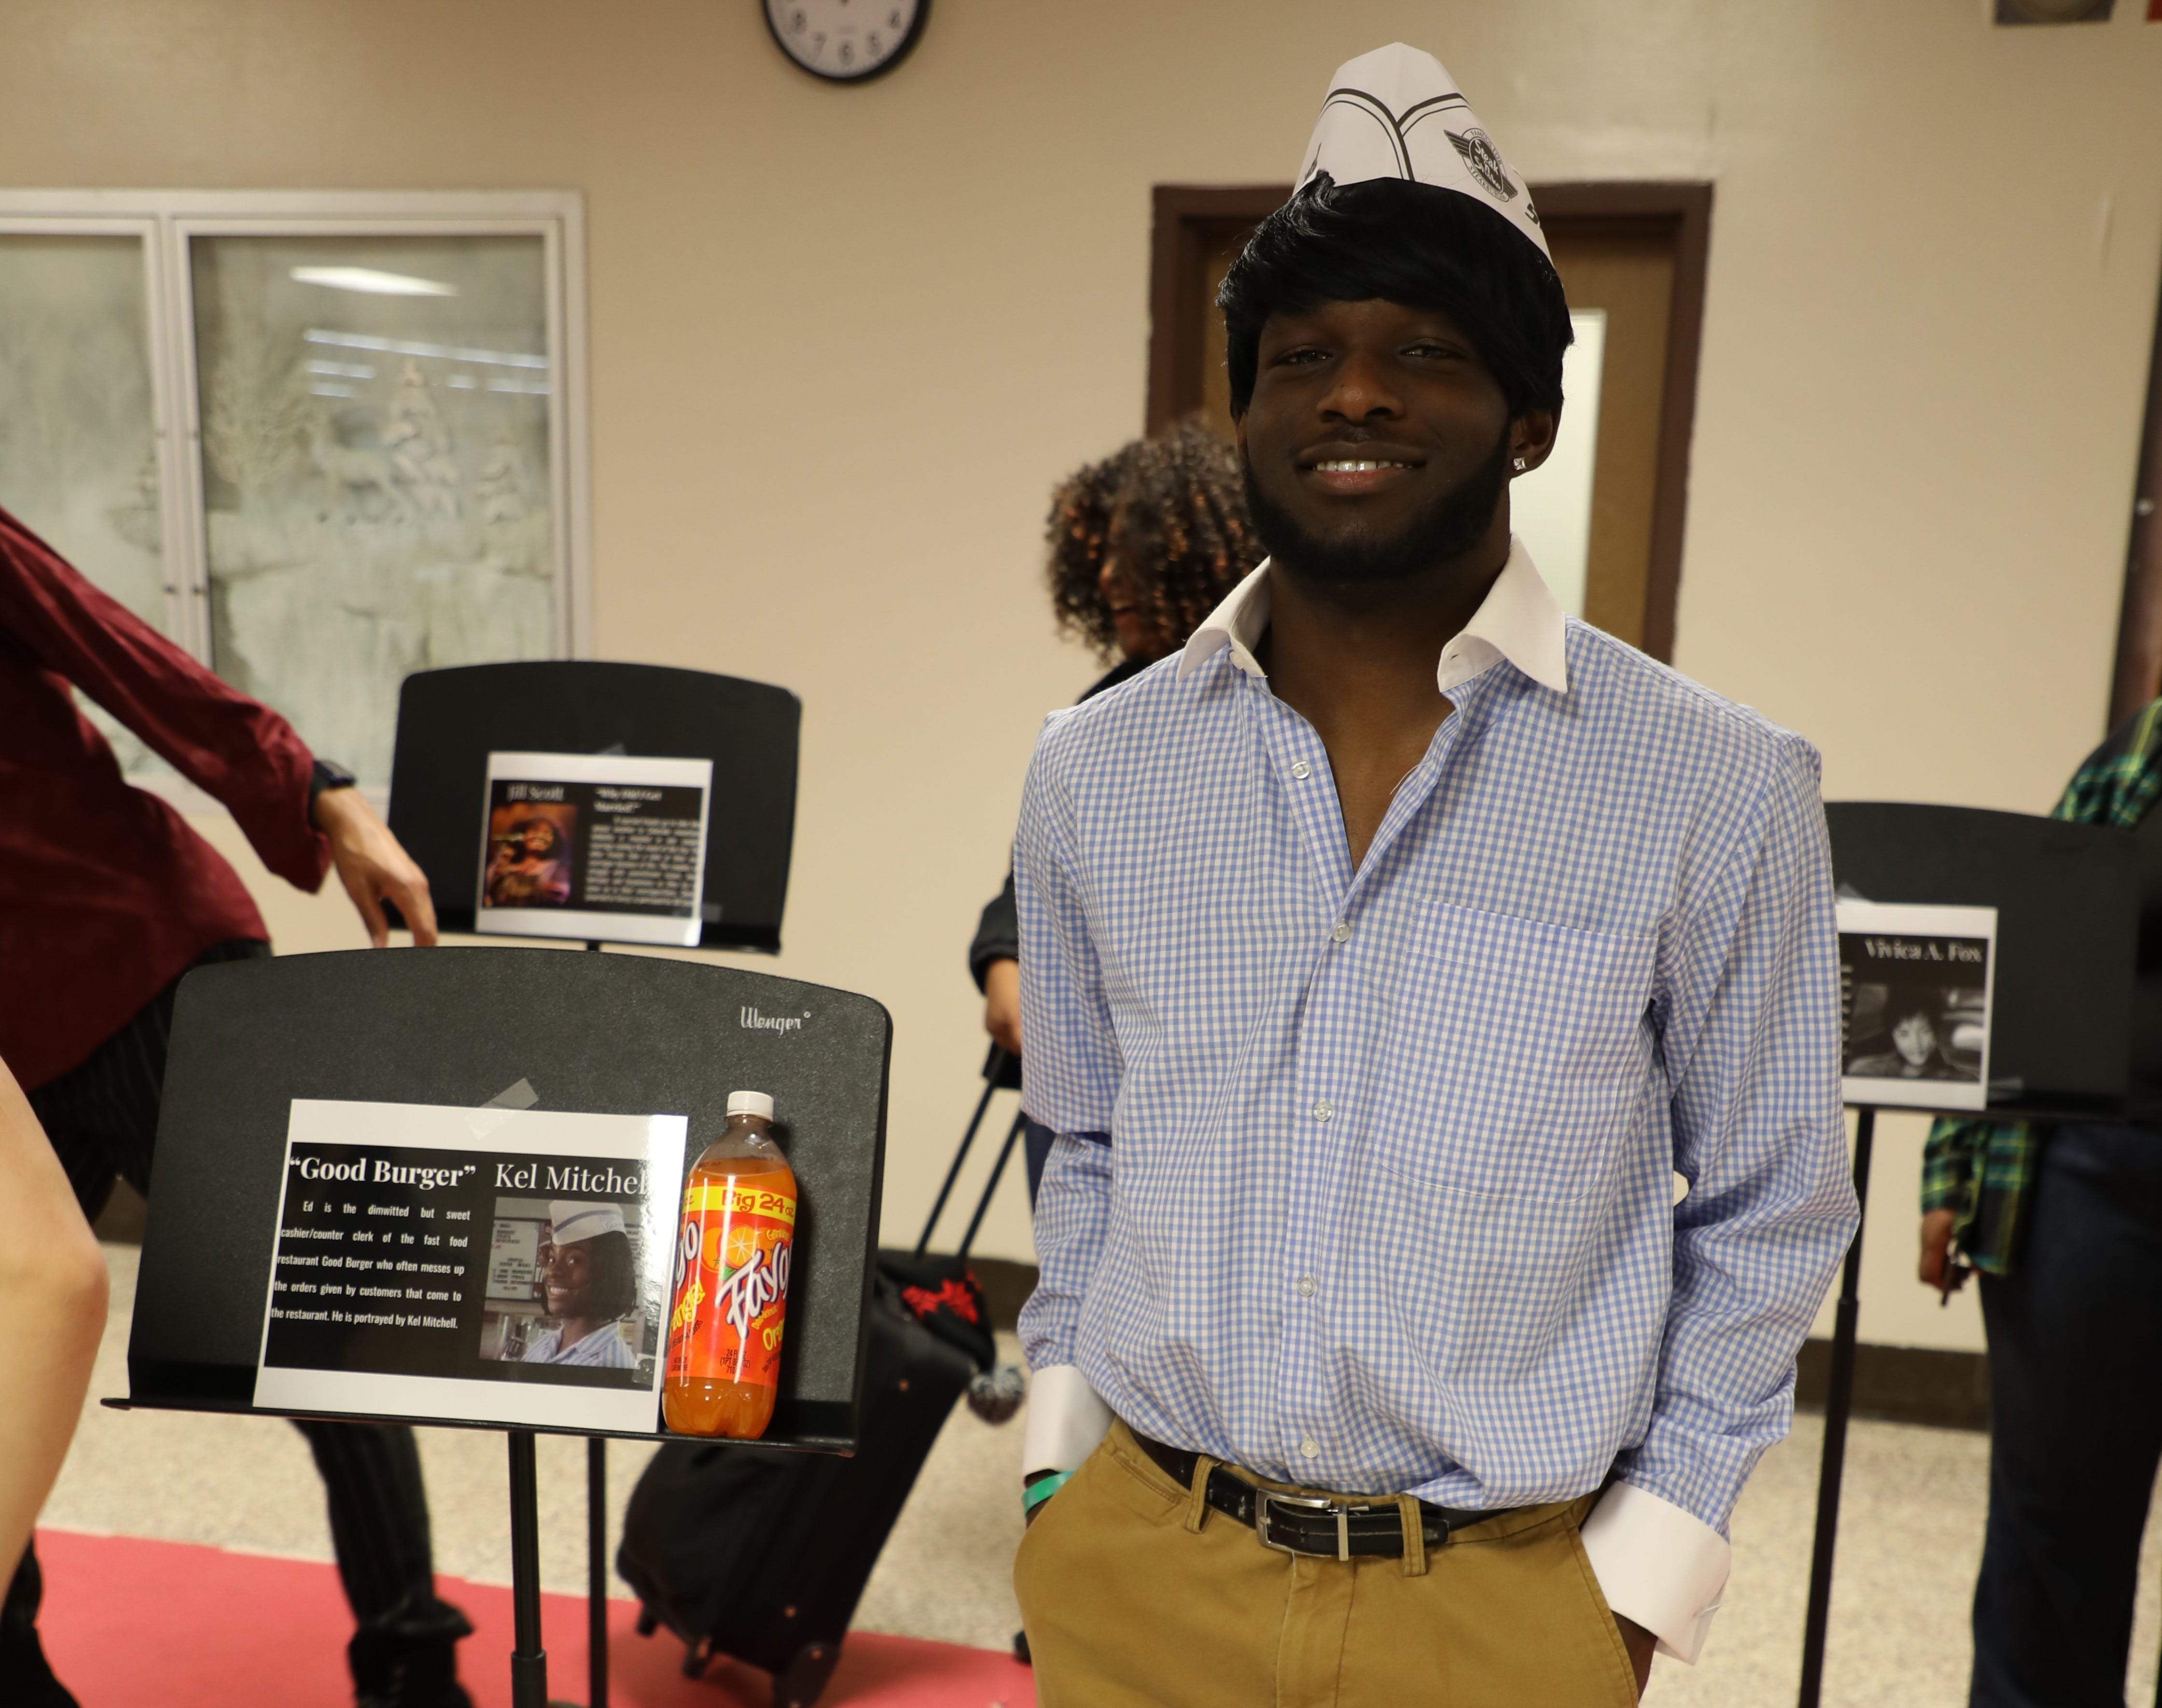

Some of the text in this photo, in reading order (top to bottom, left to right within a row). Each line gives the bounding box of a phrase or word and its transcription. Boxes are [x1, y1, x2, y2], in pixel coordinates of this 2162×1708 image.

[1475, 139, 1499, 175] Steak
[507, 783, 564, 803] Jill Scott
[1865, 938, 1922, 960] Vivica
[1948, 942, 1983, 963] Fox
[290, 1157, 476, 1190] “Good Burger”
[494, 1163, 649, 1194] Kel Mitchel
[303, 1200, 471, 1222] Ed is the dimwitted but sweet
[722, 1189, 755, 1212] Big
[759, 1193, 785, 1214] 24
[280, 1227, 468, 1248] cashier/counter clerk of the fast food
[277, 1255, 465, 1276] restaurant Good Burger who often messes up
[274, 1280, 462, 1302] the orders given by customers that come to
[715, 1240, 793, 1339] Fayg
[271, 1307, 458, 1329] the restaurant. He is portrayed by Kel Mitchell.
[726, 1348, 733, 1357] 24
